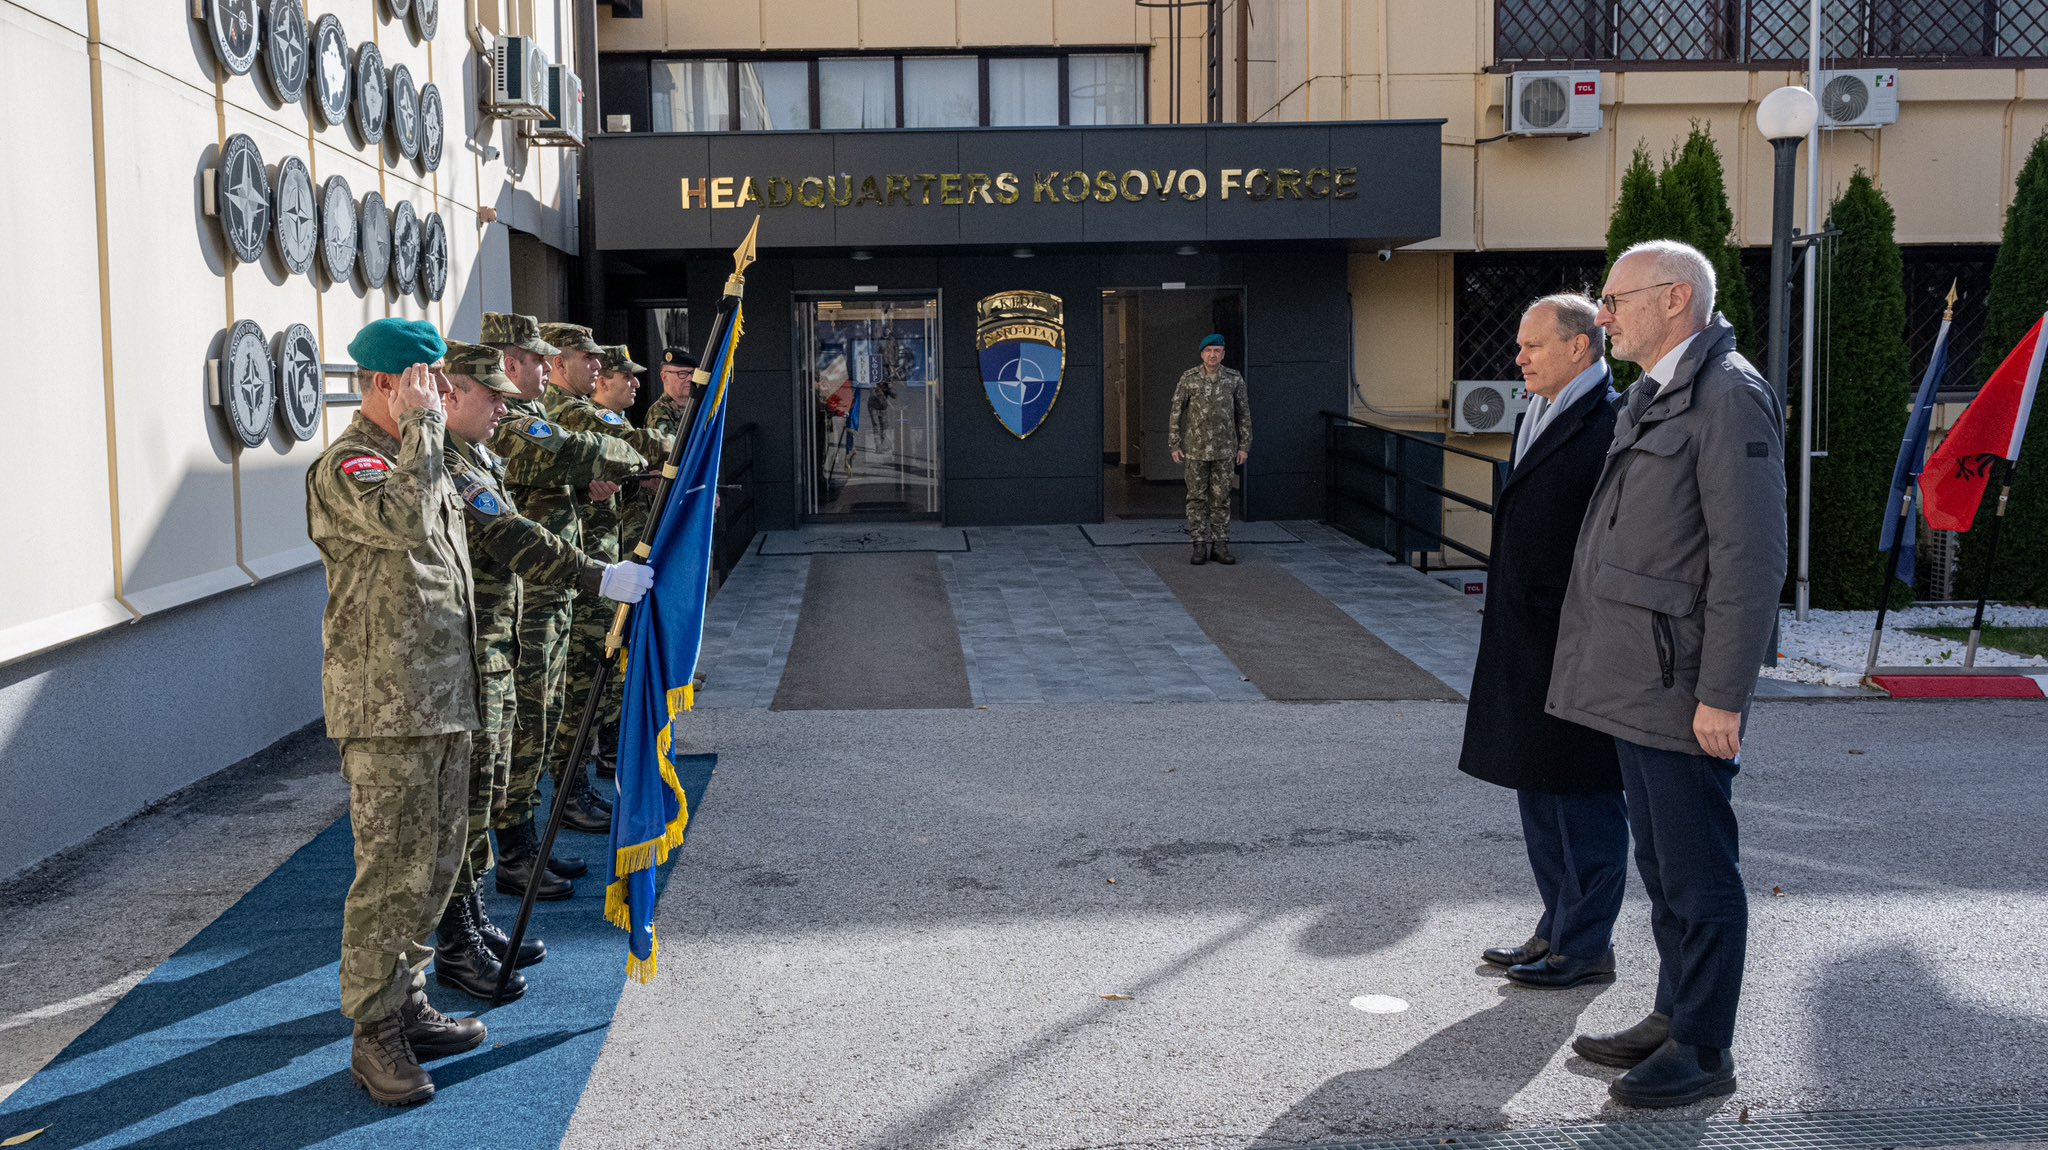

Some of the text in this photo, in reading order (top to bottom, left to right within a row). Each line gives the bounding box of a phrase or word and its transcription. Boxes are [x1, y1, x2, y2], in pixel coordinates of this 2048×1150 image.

[681, 167, 1358, 209] HEADQUARTERS KOSOVO FORCE
[1000, 296, 1040, 309] KFOR
[984, 326, 1058, 342] NATO-OTAN
